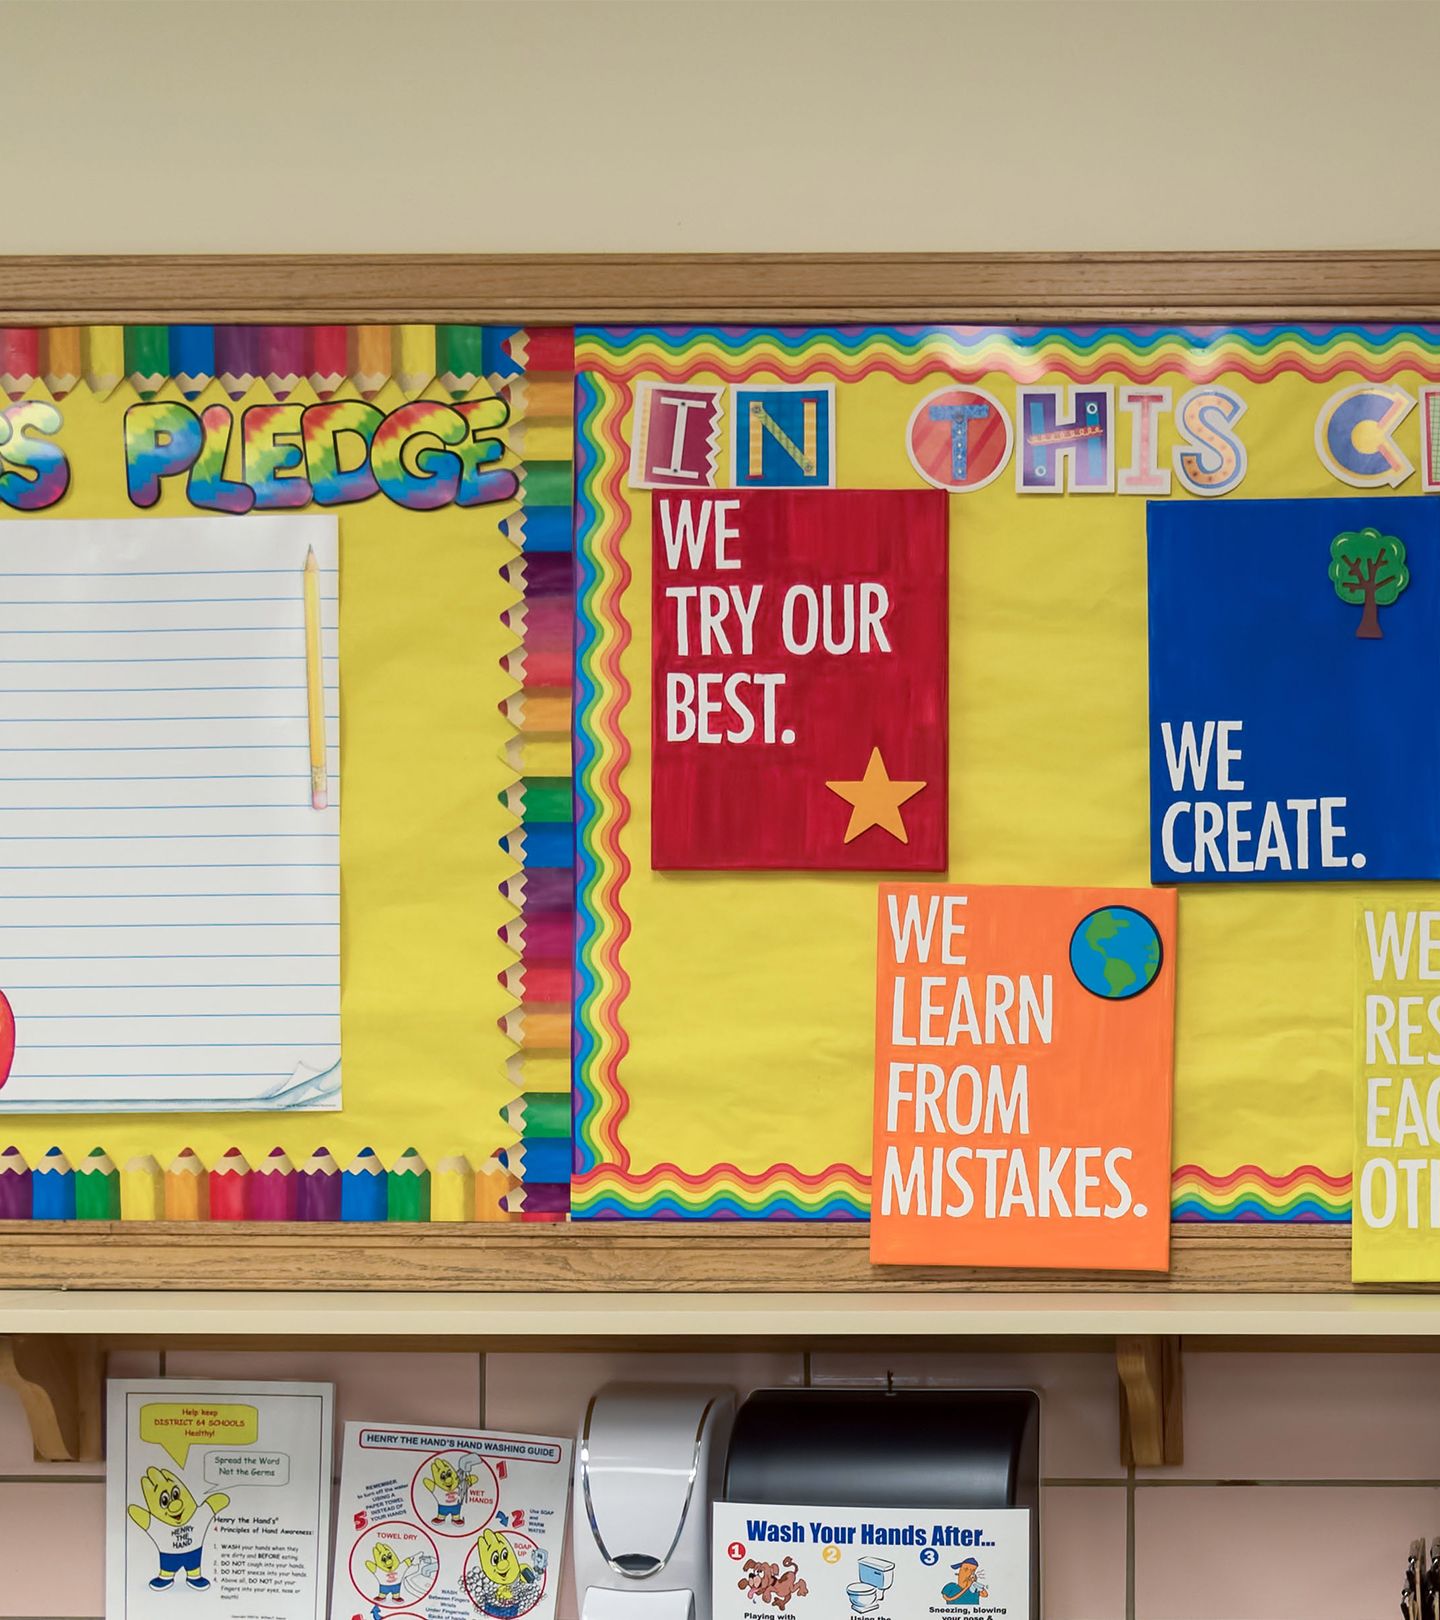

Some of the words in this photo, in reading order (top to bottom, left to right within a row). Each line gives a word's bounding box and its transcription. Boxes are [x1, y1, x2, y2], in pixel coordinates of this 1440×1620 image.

[643, 390, 824, 485] IN
[923, 387, 1246, 492] THIS
[0, 400, 71, 511] S
[124, 397, 519, 514] PLEDGE
[659, 499, 741, 570] WE
[665, 585, 763, 656] TRY
[782, 582, 892, 655] OUR
[665, 671, 795, 745] BEST.
[1161, 719, 1244, 792] WE
[1161, 798, 1367, 873] CREATE.
[887, 894, 968, 966] WE
[890, 973, 1053, 1047] LEARN
[885, 1062, 1030, 1135] FROM
[880, 1146, 1148, 1219] MISTAKES.
[182, 1408, 199, 1417] Help
[201, 1408, 218, 1417] keep
[367, 1433, 398, 1444] HENRY
[400, 1436, 418, 1446] THE
[420, 1437, 455, 1448] HAND'S
[457, 1440, 483, 1450] HAND
[484, 1441, 526, 1454] WASHING
[528, 1446, 555, 1457] GUIDE
[214, 1456, 242, 1465] Spread
[244, 1456, 257, 1465] the
[259, 1457, 280, 1465] Word
[496, 1461, 508, 1480] 1
[219, 1468, 234, 1476] Not
[236, 1468, 249, 1476] the
[251, 1468, 275, 1477] Germs
[469, 1496, 494, 1505] HANDS
[213, 1516, 235, 1525] Henry
[354, 1510, 368, 1531] 5
[511, 1509, 525, 1529] 2
[171, 1525, 194, 1536] HENRY
[176, 1533, 189, 1541] THE
[746, 1520, 805, 1543] Wash
[809, 1522, 856, 1544] Your
[861, 1523, 927, 1546] Hands
[931, 1525, 995, 1547] After...
[172, 1538, 193, 1549] HAND
[744, 1612, 775, 1620] Playing
[928, 1606, 971, 1615] Sneezing,
[973, 1607, 1007, 1615] blowing
